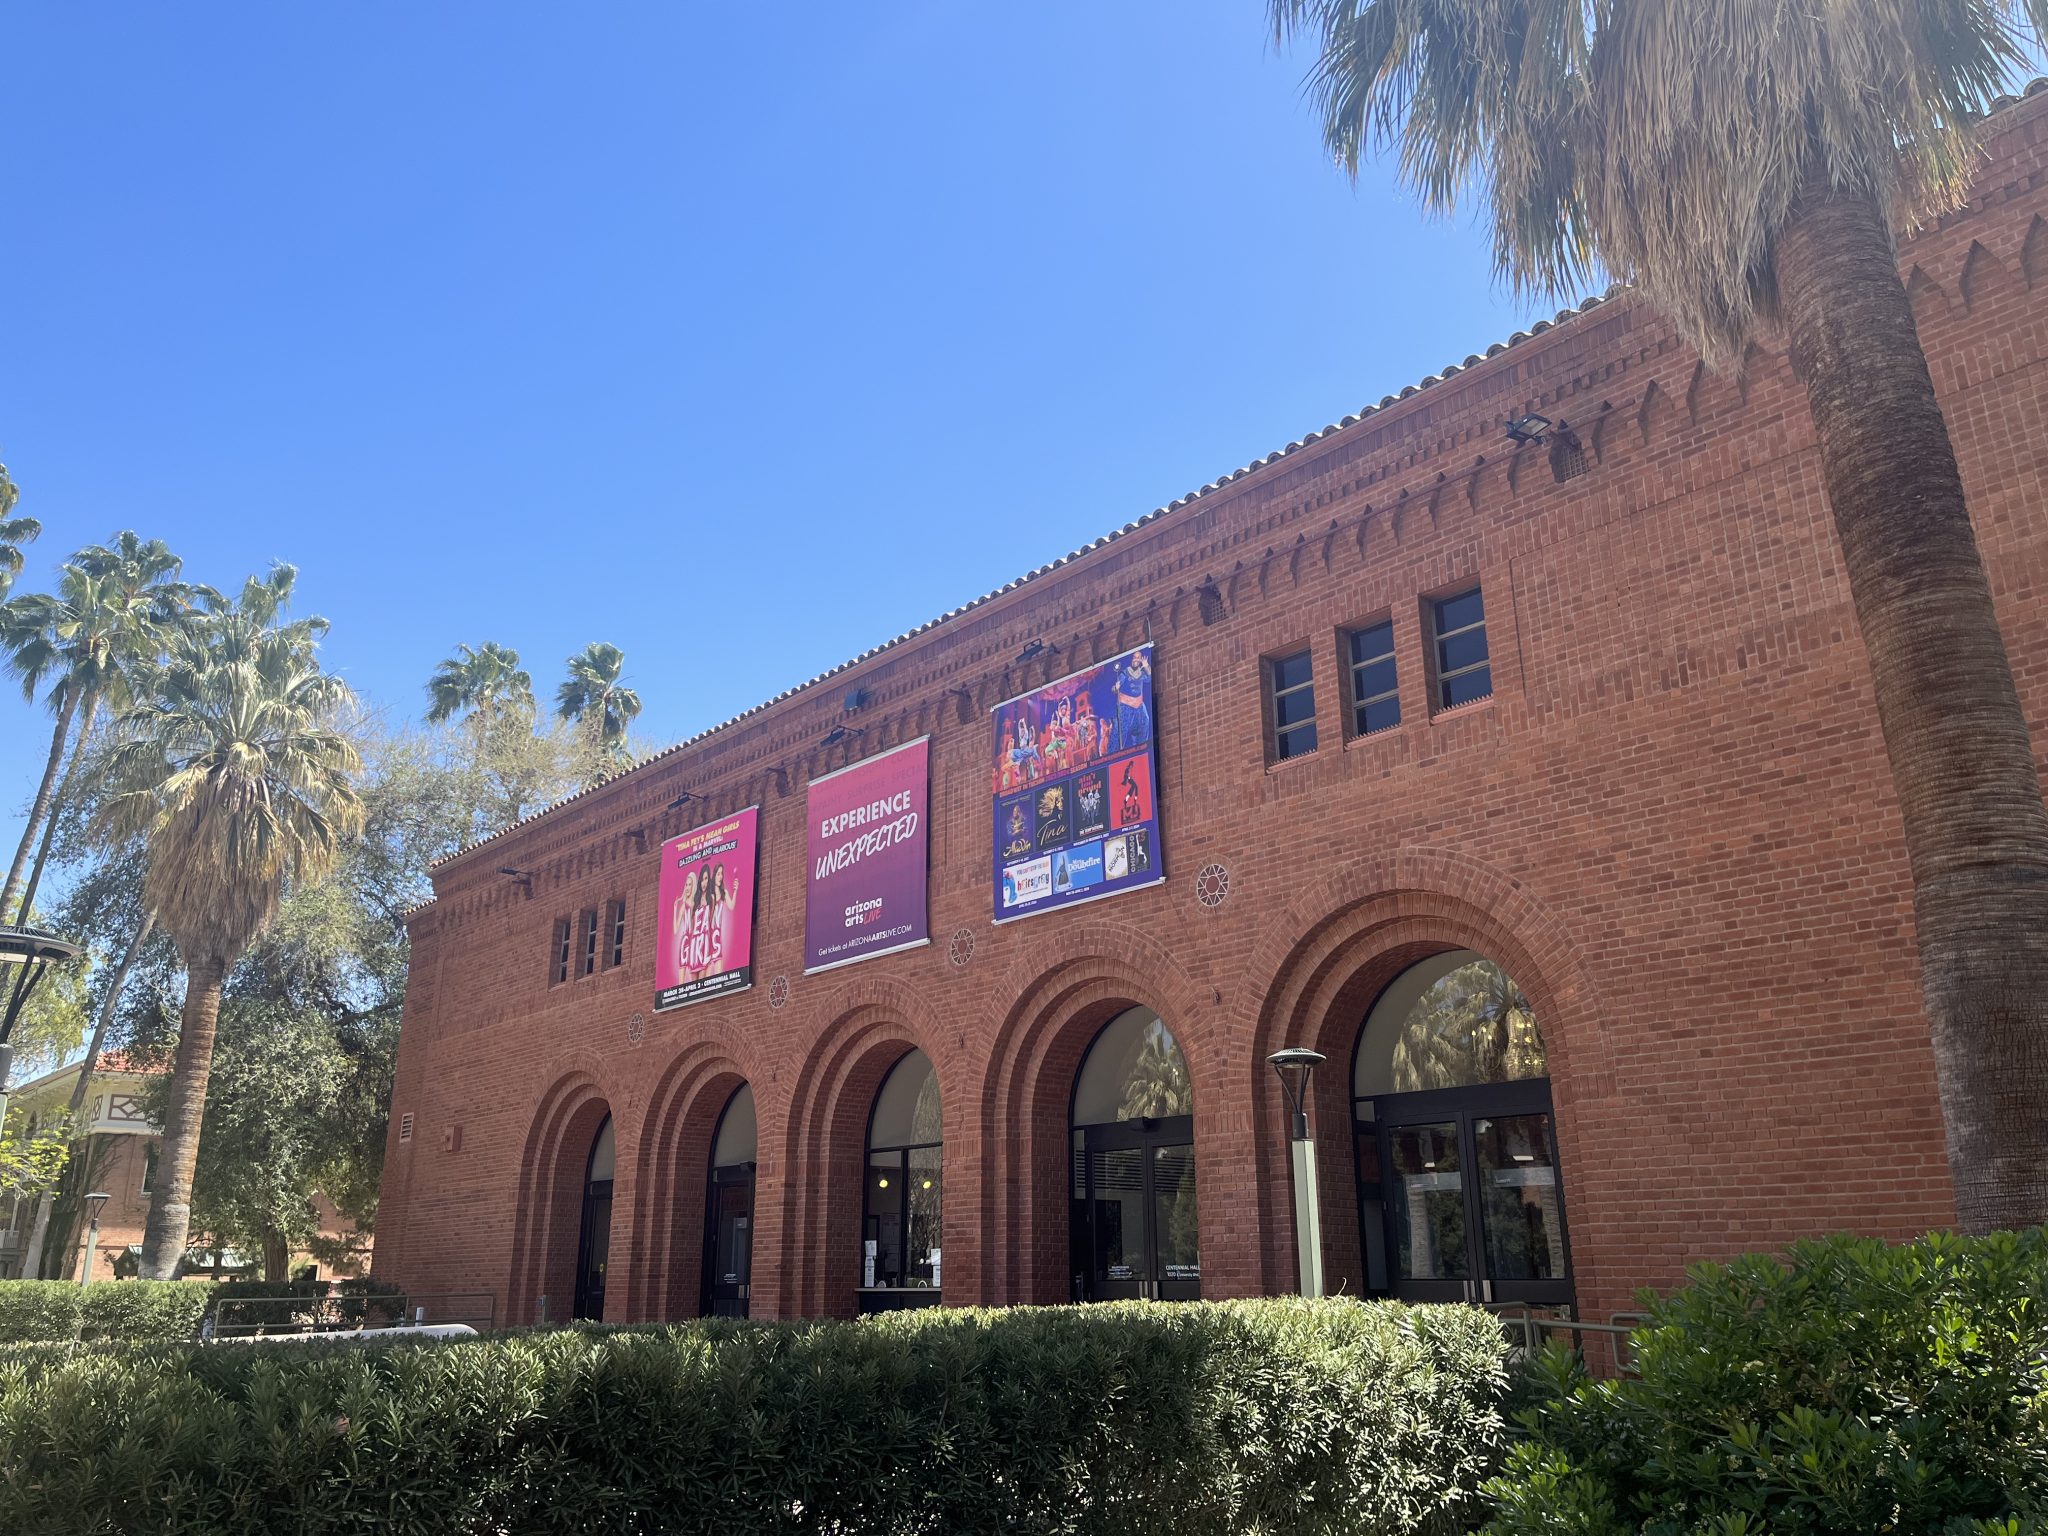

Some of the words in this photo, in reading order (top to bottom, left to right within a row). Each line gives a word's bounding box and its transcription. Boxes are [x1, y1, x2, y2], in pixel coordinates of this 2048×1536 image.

[1070, 763, 1088, 774] SEASON
[722, 820, 740, 834] GIRLS
[821, 790, 911, 838] EXPERIENCE
[1037, 818, 1068, 846] Tina
[702, 846, 713, 857] AND
[815, 812, 918, 880] UNEXPECTED
[1067, 856, 1101, 872] Doubtfire
[683, 902, 724, 936] MEAN
[845, 897, 882, 917] arizona
[845, 913, 864, 928] arts
[863, 907, 882, 925] LIVE
[681, 929, 722, 967] GIRLS
[818, 948, 828, 957] Get
[848, 923, 912, 948] ARIZONAARTSLIVE.COM
[664, 989, 678, 998] MARCH
[704, 974, 729, 987] CENTENNIAL
[729, 971, 741, 980] HALL
